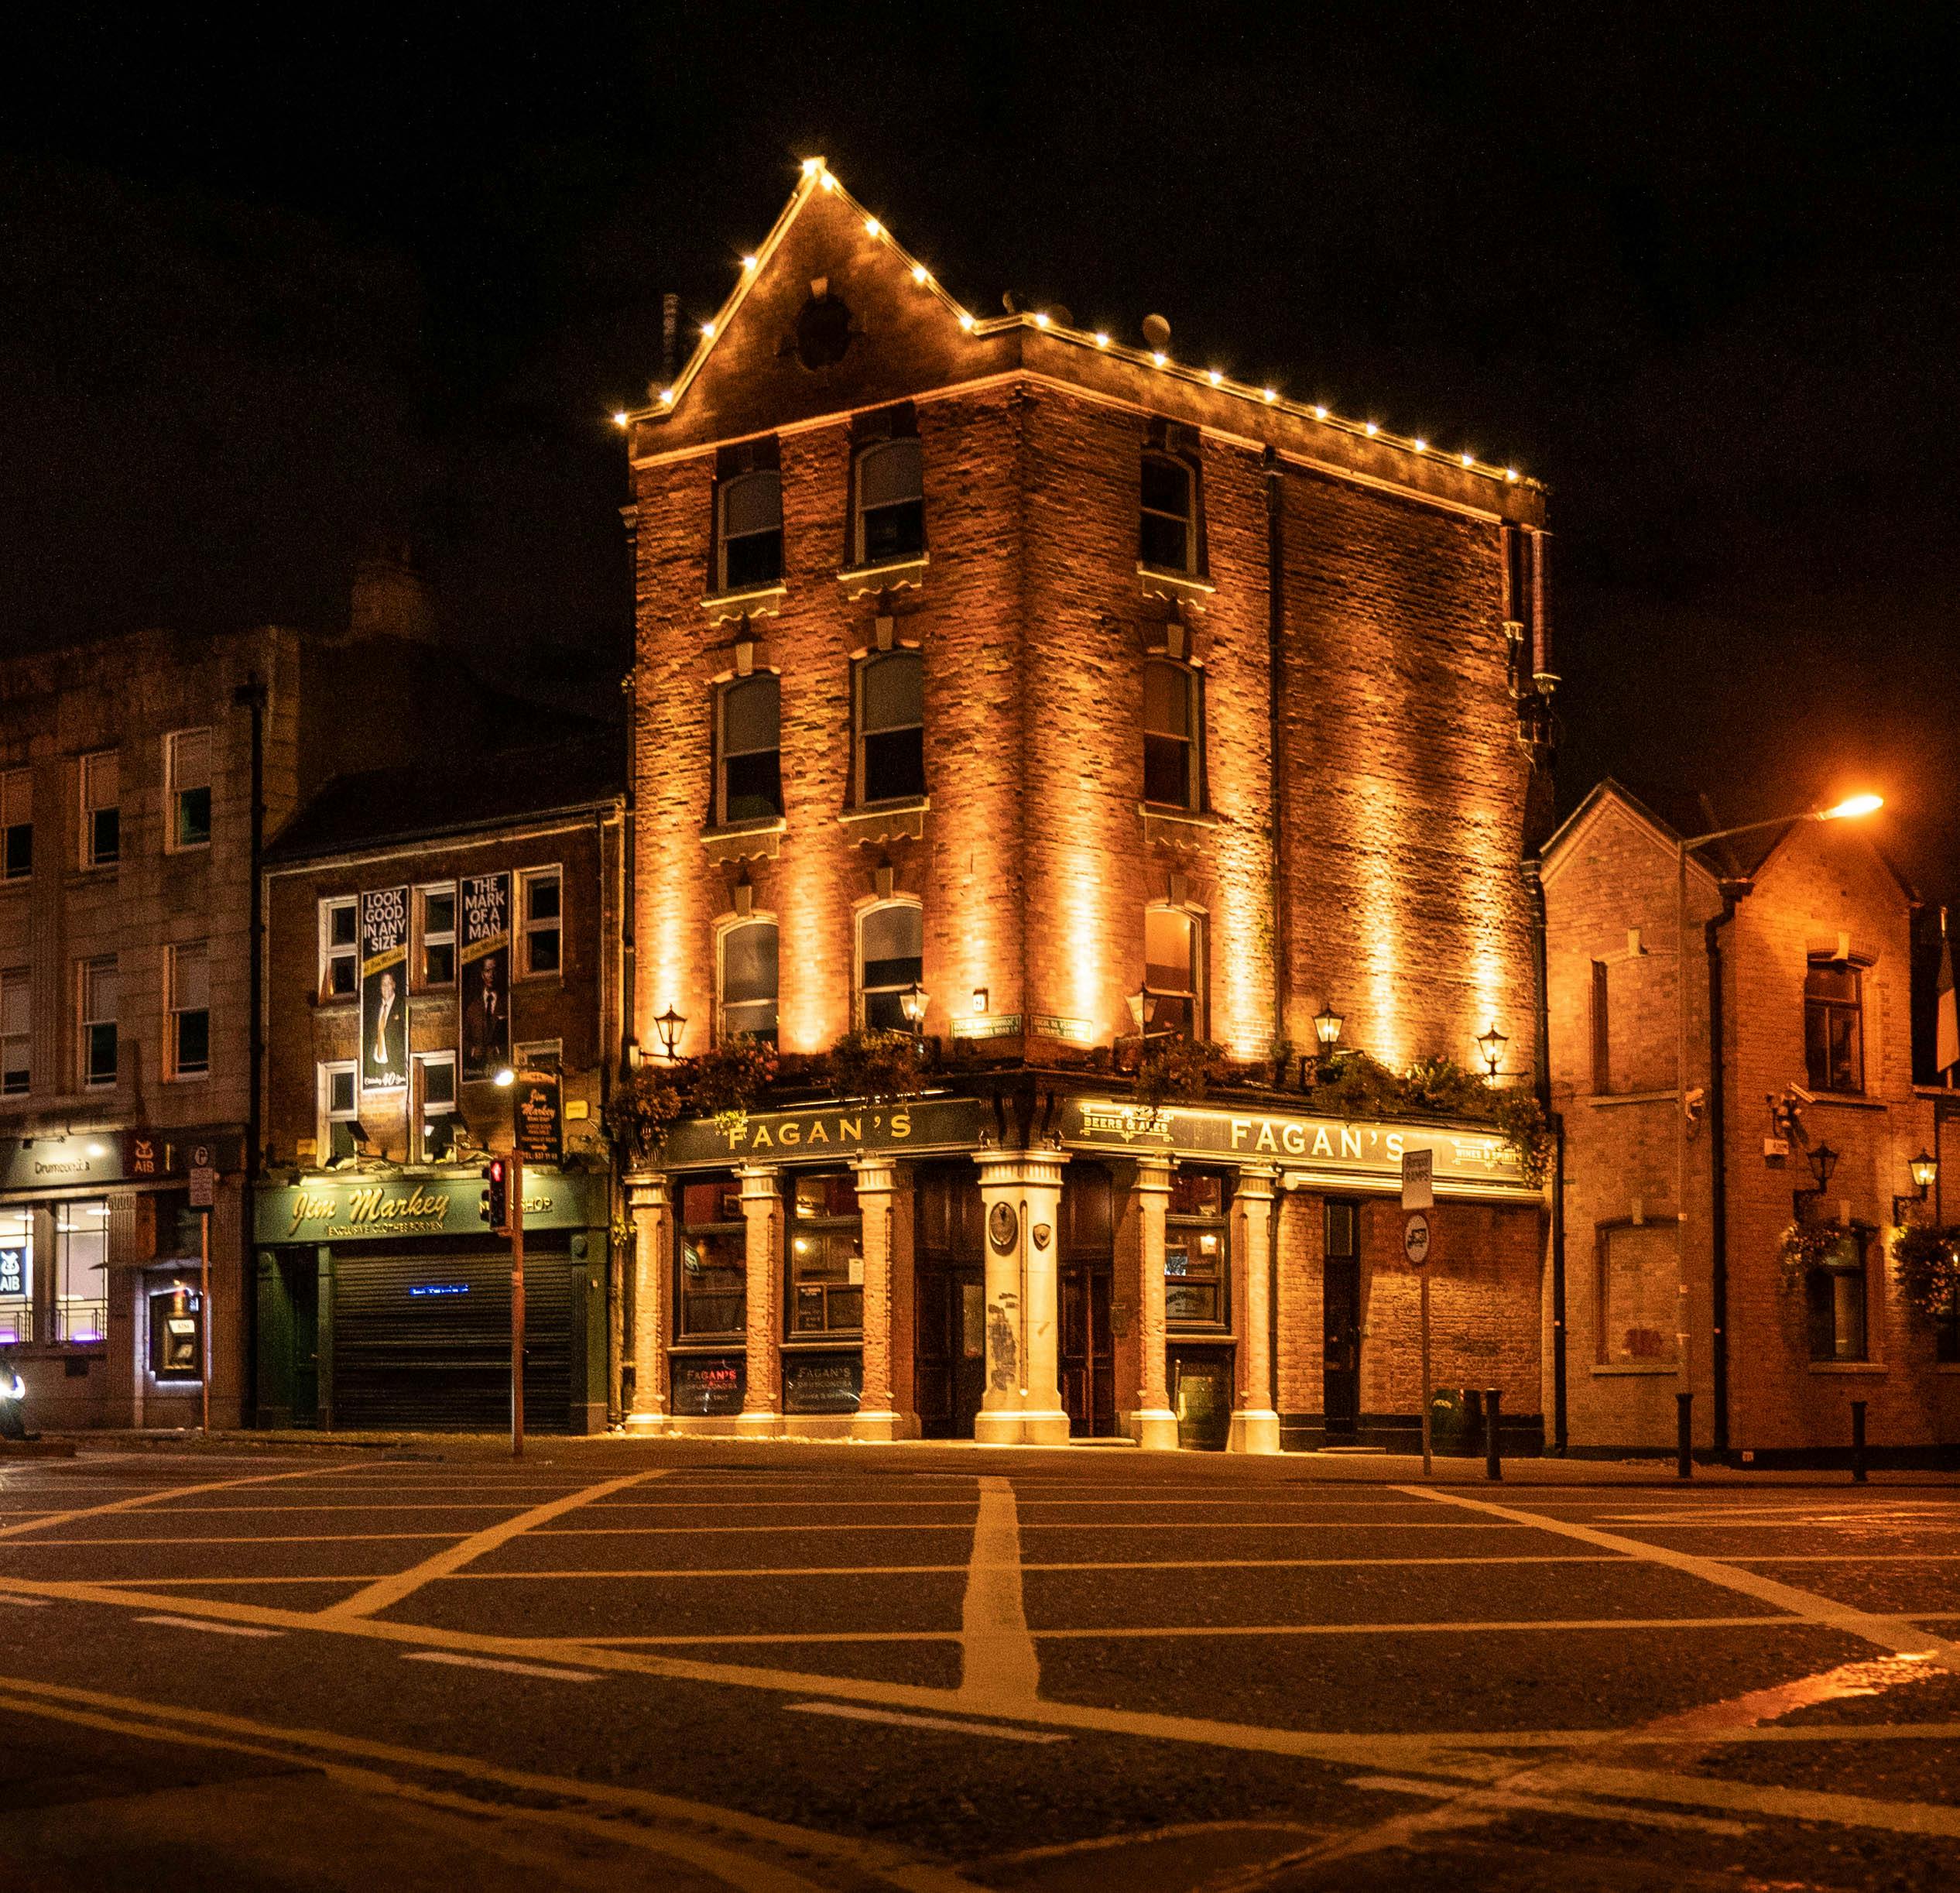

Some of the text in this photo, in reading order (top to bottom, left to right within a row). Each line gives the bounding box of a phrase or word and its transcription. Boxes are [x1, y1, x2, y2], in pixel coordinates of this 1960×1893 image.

[472, 877, 498, 894] THE
[367, 891, 403, 908] LOOK
[465, 890, 505, 910] MARK
[365, 905, 404, 923] GOOD
[470, 907, 501, 924] OF A
[364, 919, 406, 938] IN ANY
[469, 923, 501, 940] MAN
[372, 934, 398, 952] SIZE
[729, 1114, 912, 1151] FAGAN'S
[1084, 1116, 1169, 1133] BEERS & ALES
[1231, 1119, 1405, 1162] FAGAN'S
[1455, 1149, 1482, 1159] WINES
[1492, 1151, 1523, 1162] SPIRIT
[134, 1161, 155, 1174] AIB
[289, 1185, 451, 1237] Jim Markey
[327, 1224, 370, 1237] EXCLUSIVE
[372, 1222, 408, 1234] CLOTHES
[0, 1276, 20, 1291] AIB
[686, 1369, 737, 1380] FAGAN'S
